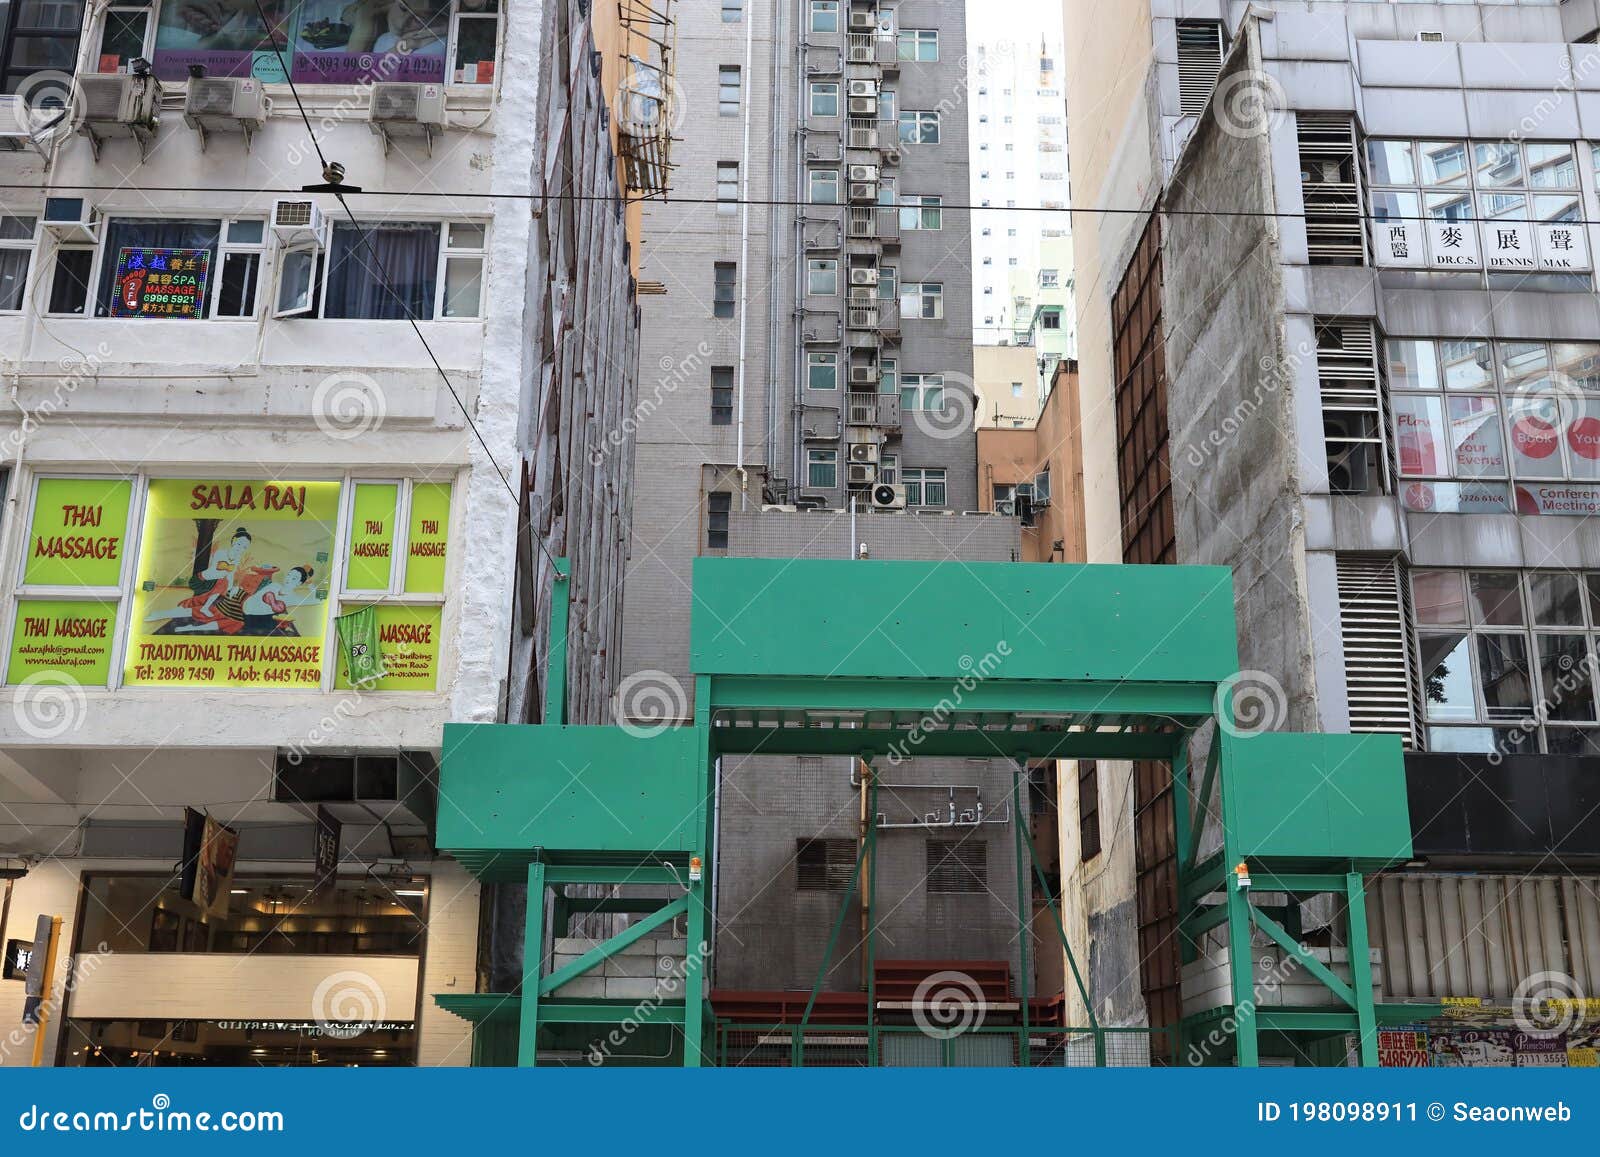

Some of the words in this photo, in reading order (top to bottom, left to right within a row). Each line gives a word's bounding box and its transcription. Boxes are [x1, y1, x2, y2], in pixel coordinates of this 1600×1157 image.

[1437, 255, 1477, 265] DR.C.S.
[1490, 257, 1534, 267] DENNIS
[1543, 258, 1571, 268] MAK
[145, 285, 195, 295] MASSAGE
[170, 295, 195, 304] 5921
[190, 484, 256, 511] SALA
[264, 485, 306, 517] RAJ
[62, 505, 102, 527] THAI
[365, 520, 382, 535] THAI
[421, 520, 438, 535] THAI
[35, 536, 119, 560] MASSAGE
[354, 543, 389, 557] MASSAGE
[410, 542, 446, 557] MASSAGE
[24, 617, 50, 637] THAI
[54, 617, 108, 638] MASSAGE
[380, 624, 432, 644] MASSAGE
[140, 643, 223, 662] TRADITIONAL
[227, 644, 257, 662] THAI
[259, 645, 320, 663] MASSAGE
[25, 656, 96, 668] www.salaraj.com
[134, 665, 154, 680] Tel:
[158, 666, 185, 680] 2898
[188, 667, 215, 681] 7450
[227, 666, 260, 682] Mob:
[264, 668, 291, 682] 6445
[294, 669, 321, 682] 7450
[1543, 1055, 1566, 1064] 3555
